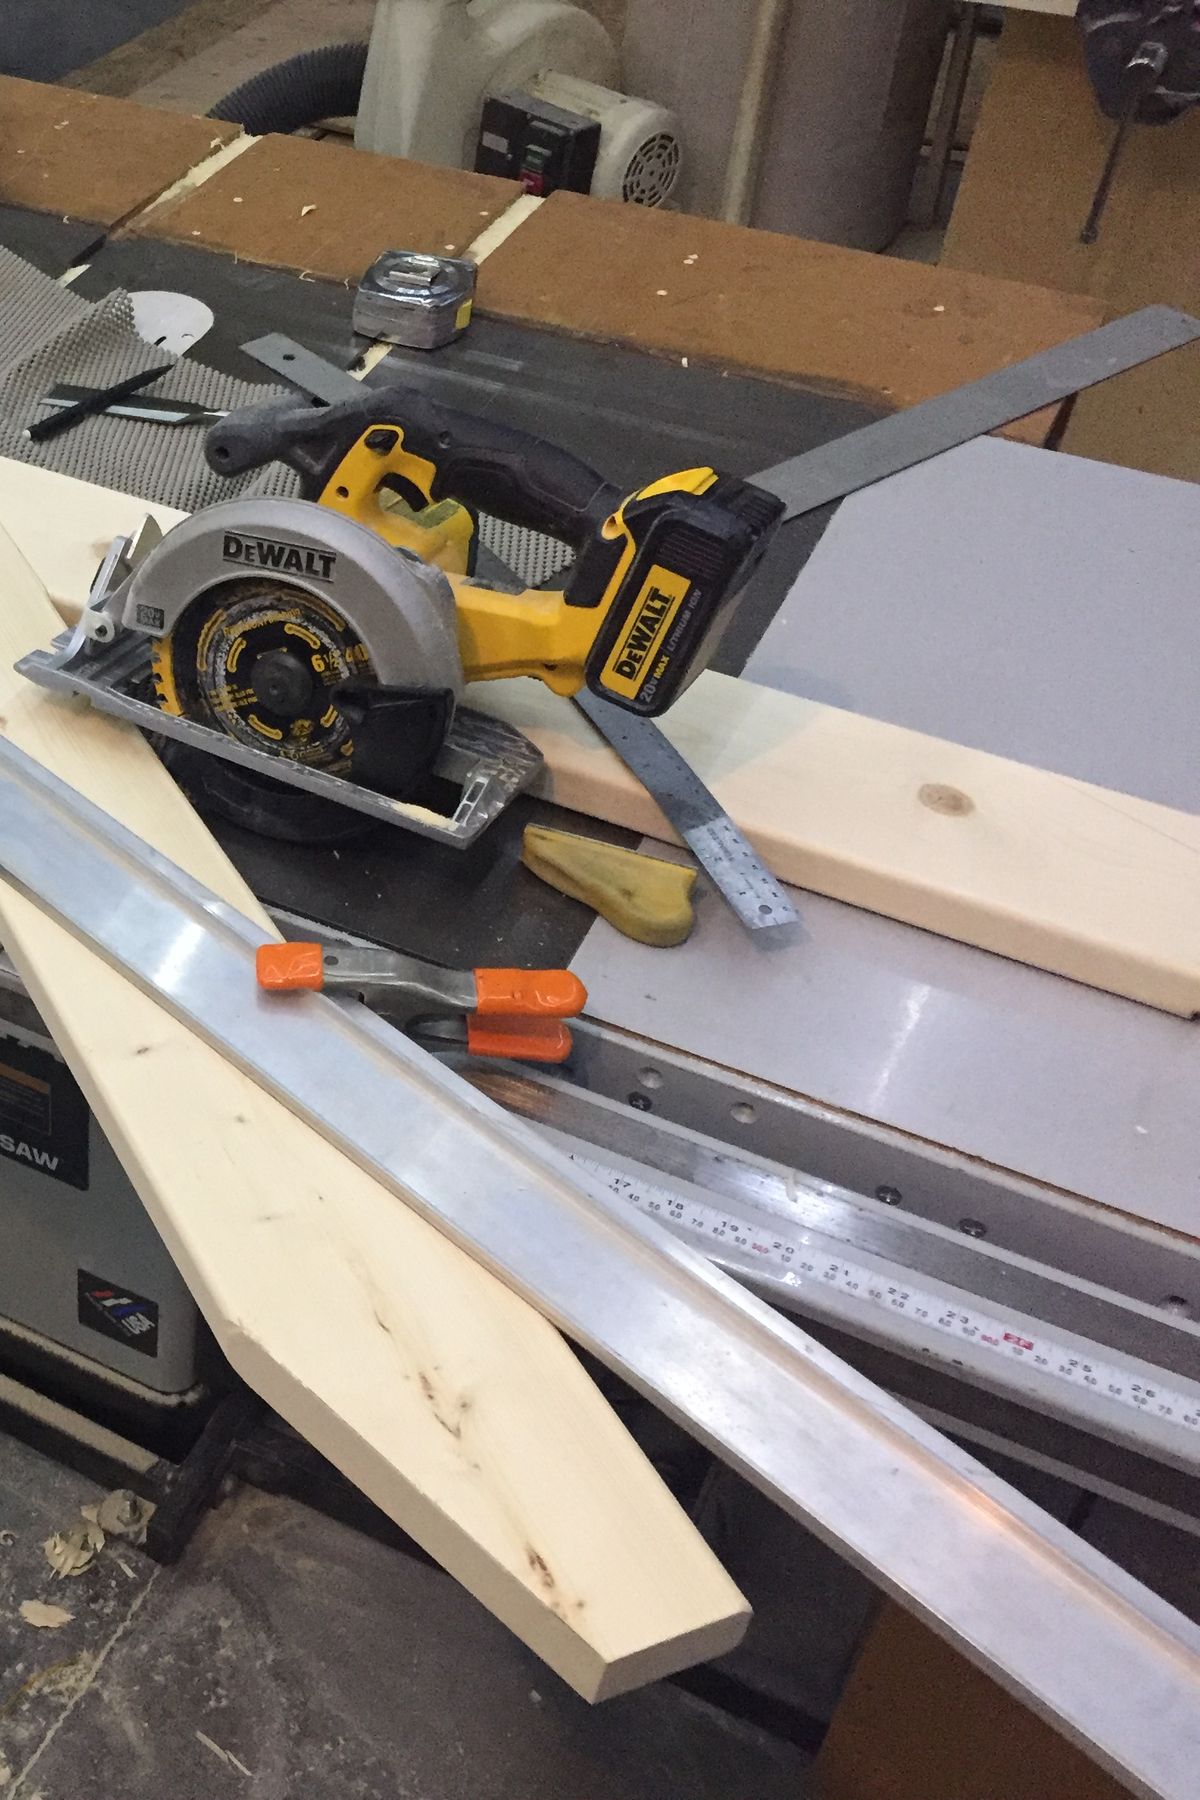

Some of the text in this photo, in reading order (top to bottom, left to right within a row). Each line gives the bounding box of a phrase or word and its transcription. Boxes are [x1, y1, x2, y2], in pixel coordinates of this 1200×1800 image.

[223, 535, 336, 578] DEWALT
[615, 587, 674, 680] DEWALT
[653, 654, 670, 679] MAX
[667, 609, 692, 651] LITHIUM
[689, 589, 702, 612] ION
